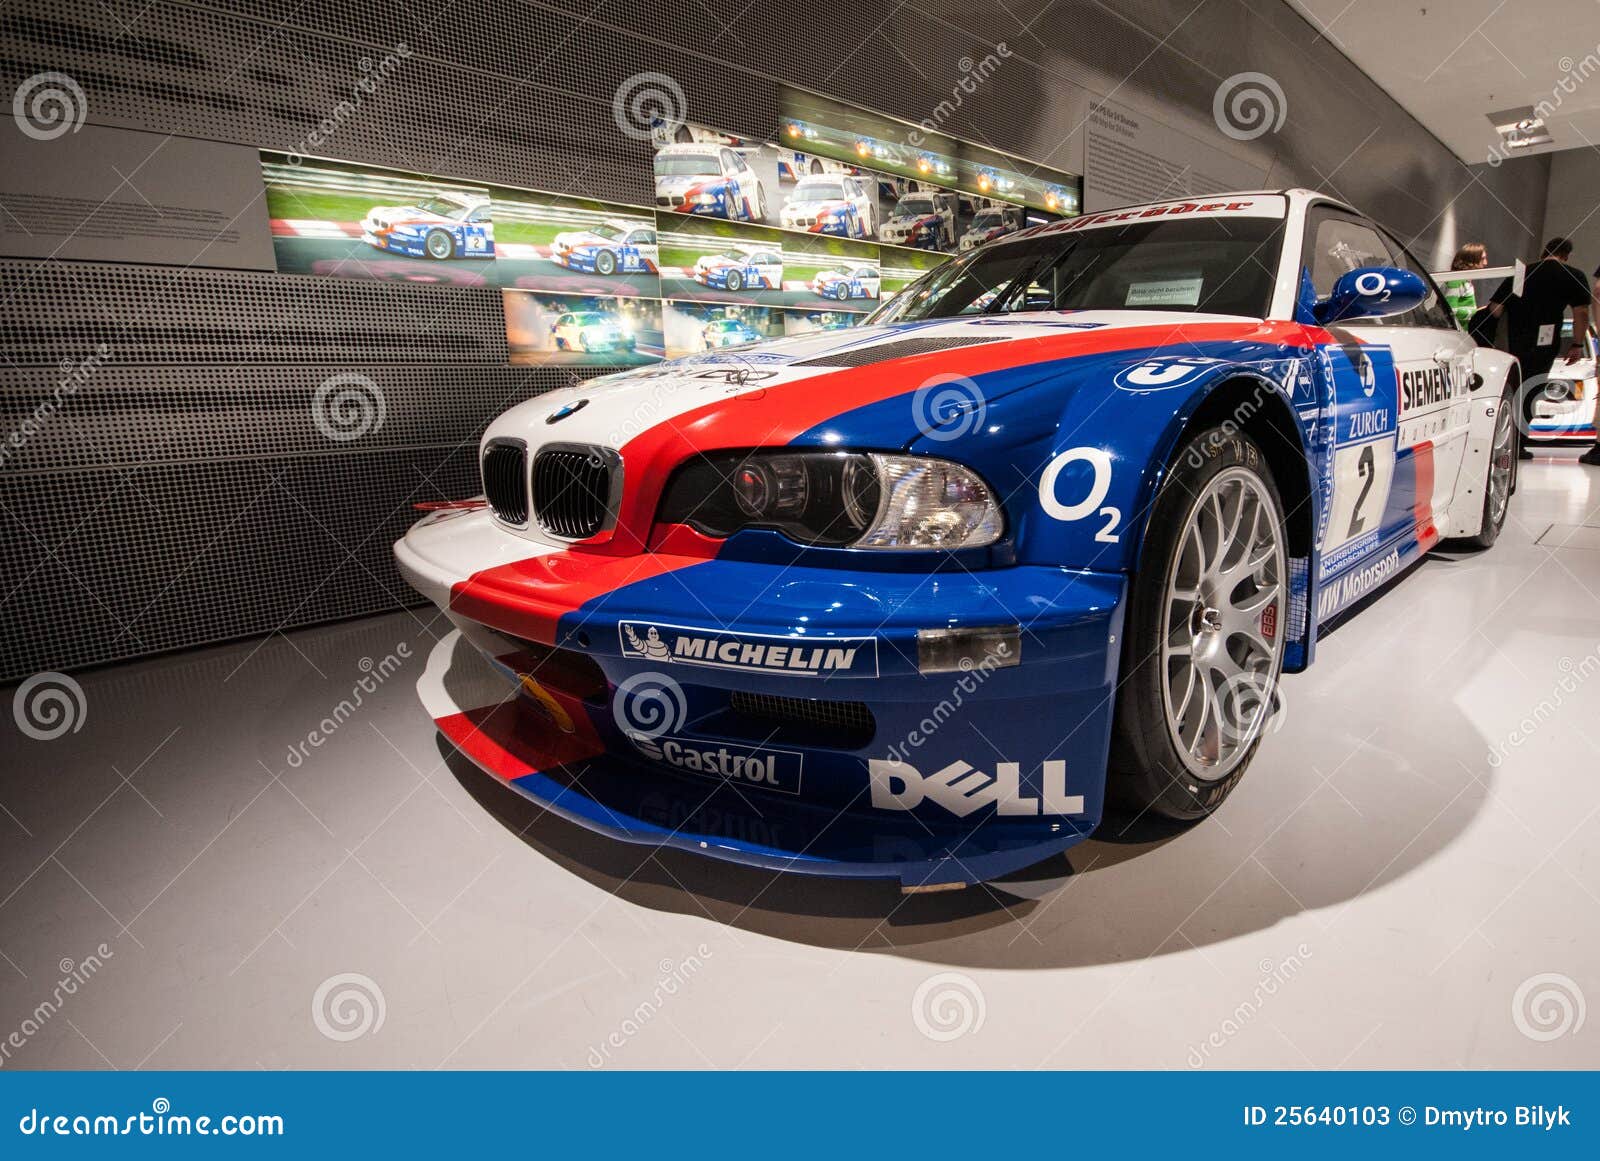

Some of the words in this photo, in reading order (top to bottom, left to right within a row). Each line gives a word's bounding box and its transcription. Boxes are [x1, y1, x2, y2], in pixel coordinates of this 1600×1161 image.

[1403, 366, 1452, 411] SIEMENS
[1349, 408, 1388, 439] ZURICH
[1346, 446, 1375, 539] 2
[1341, 546, 1400, 605] Motorsport
[1262, 605, 1276, 637] BBS
[675, 636, 856, 670] MICHELIN
[663, 740, 780, 786] Castrol
[868, 759, 1084, 818] DELL
